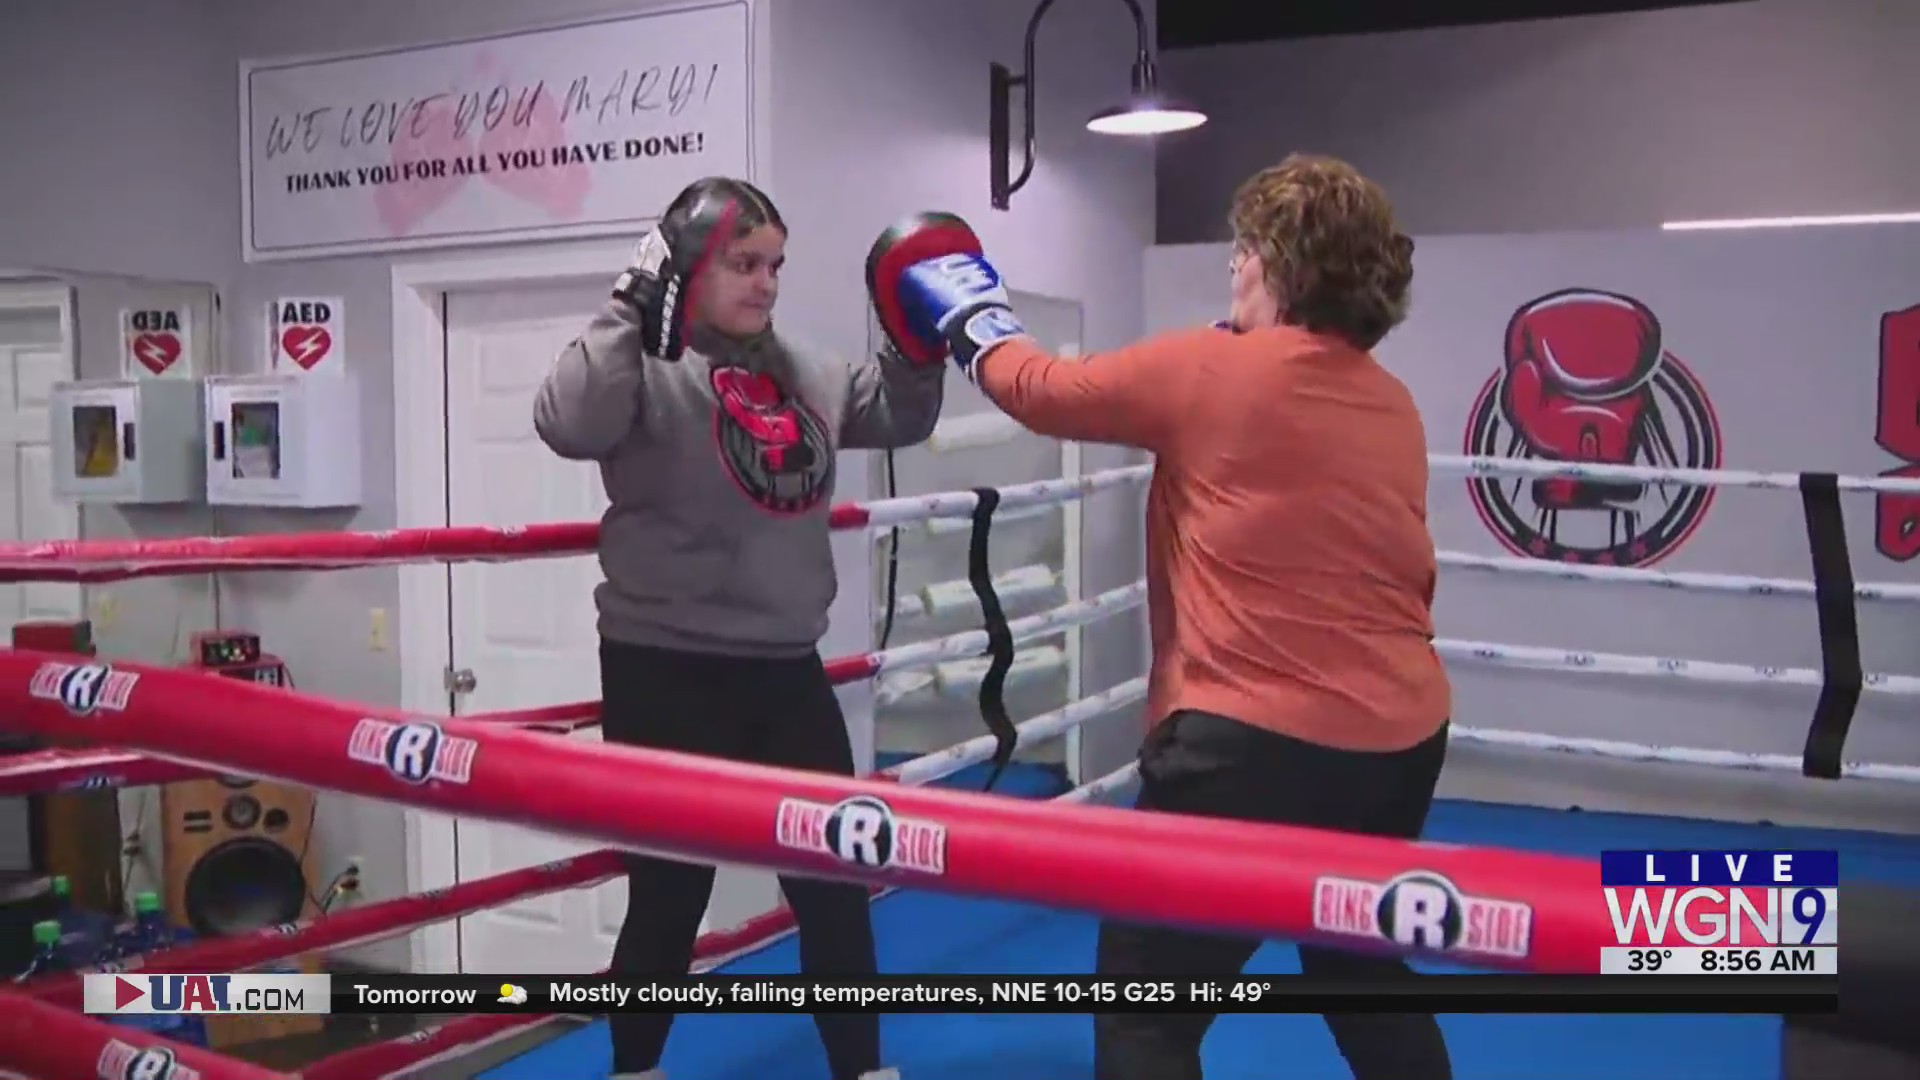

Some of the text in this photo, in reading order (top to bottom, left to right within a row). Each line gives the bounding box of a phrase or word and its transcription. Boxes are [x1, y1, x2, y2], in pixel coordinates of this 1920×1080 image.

[265, 106, 331, 160] WE
[340, 93, 450, 149] LOVE
[453, 80, 544, 141] YOU
[286, 132, 704, 193] THANK YOU FOR ALL YOU HAVE DONE!
[282, 302, 332, 324] AED
[393, 723, 434, 778] R
[780, 802, 943, 869] RING R SIDE
[1319, 880, 1527, 954] RING R SIDE
